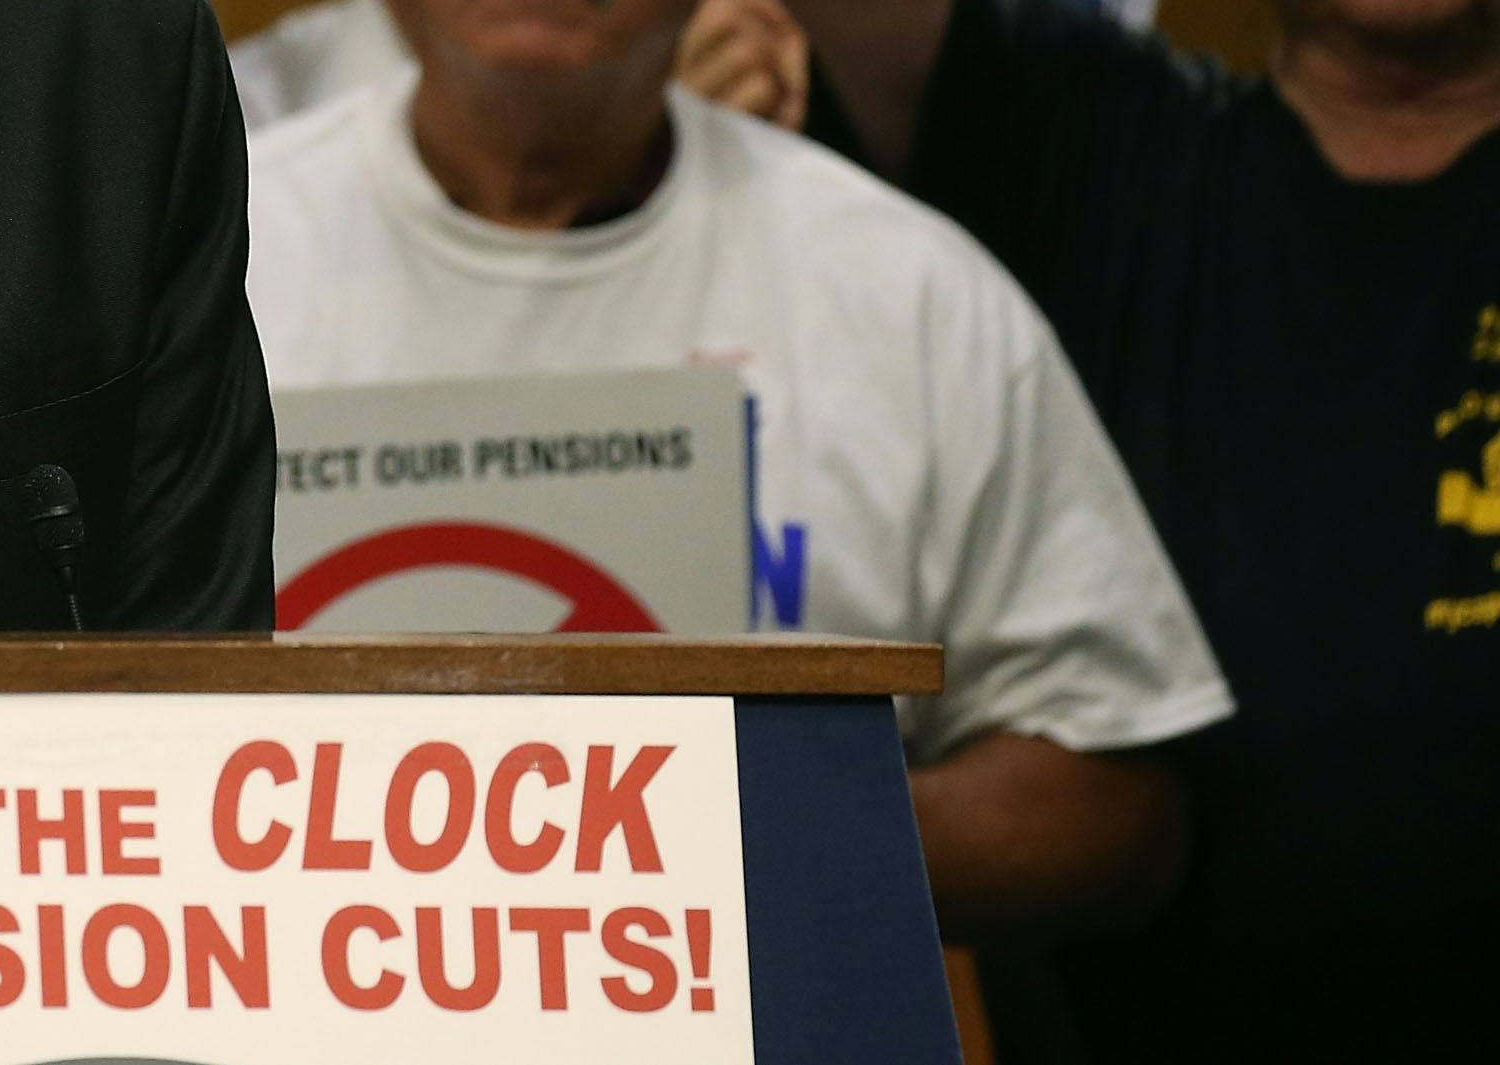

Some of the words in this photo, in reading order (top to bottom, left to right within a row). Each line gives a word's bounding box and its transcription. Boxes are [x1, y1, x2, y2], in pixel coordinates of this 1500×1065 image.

[373, 439, 465, 489] OUR
[470, 426, 696, 482] PENSIONS
[211, 739, 678, 875] CLOCK
[320, 903, 717, 1014] CUTS!
